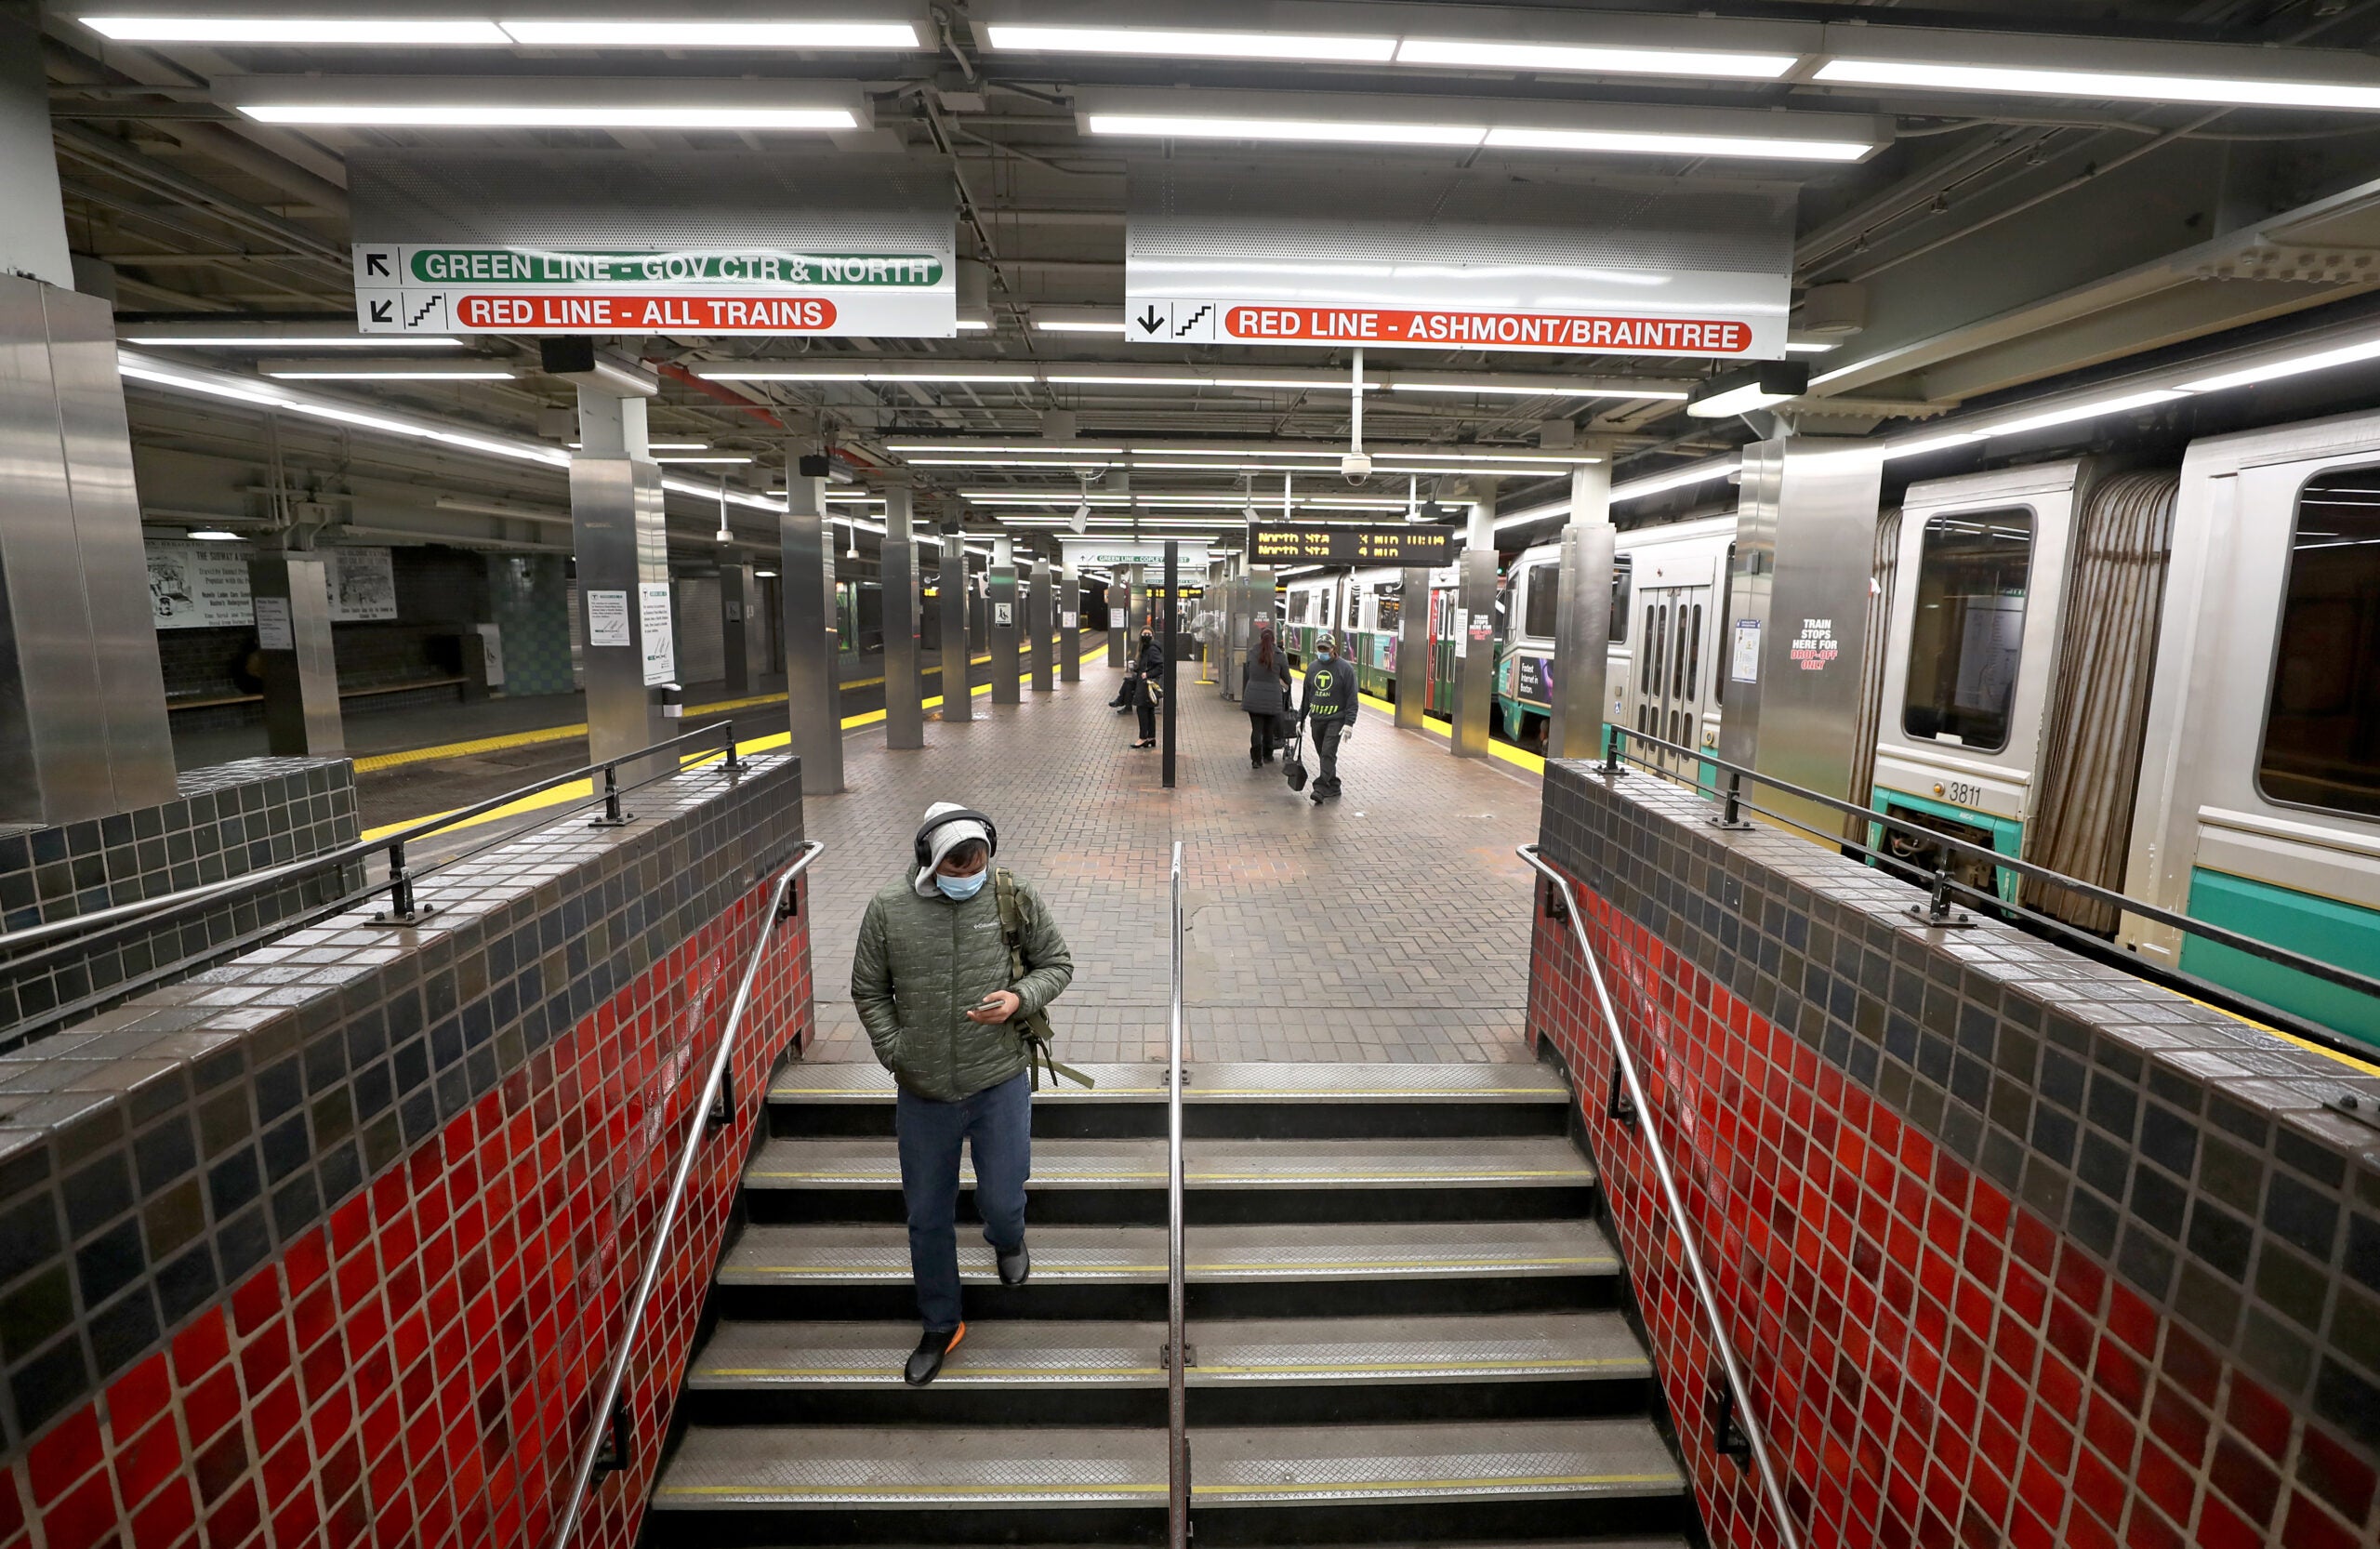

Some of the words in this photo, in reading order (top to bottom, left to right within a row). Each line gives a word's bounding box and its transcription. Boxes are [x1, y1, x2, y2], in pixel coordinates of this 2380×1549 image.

[426, 254, 531, 279] GREEN
[543, 255, 611, 280] LINE
[641, 256, 708, 279] GOV
[719, 257, 780, 281] CTR
[790, 258, 811, 282] &
[821, 258, 930, 283] NORTH
[470, 299, 534, 324] RED
[544, 300, 612, 324] LINE
[641, 300, 700, 324] ALL
[707, 300, 823, 325] TRAINS
[1238, 310, 1301, 336] RED
[1311, 311, 1378, 338] LINE
[1407, 314, 1739, 349] ASHMONT/BRAINTREE
[1804, 618, 1831, 629] TRAIN
[1801, 629, 1831, 640] STOPS
[1792, 639, 1817, 650] HERE
[1818, 640, 1838, 650] FOR
[1791, 649, 1838, 661] DROP-OFF
[1521, 662, 1534, 673] Fastest
[1800, 659, 1826, 670] ONLY
[1317, 674, 1330, 688] T
[1520, 672, 1534, 684] Internet
[1949, 781, 1981, 807] 3811
